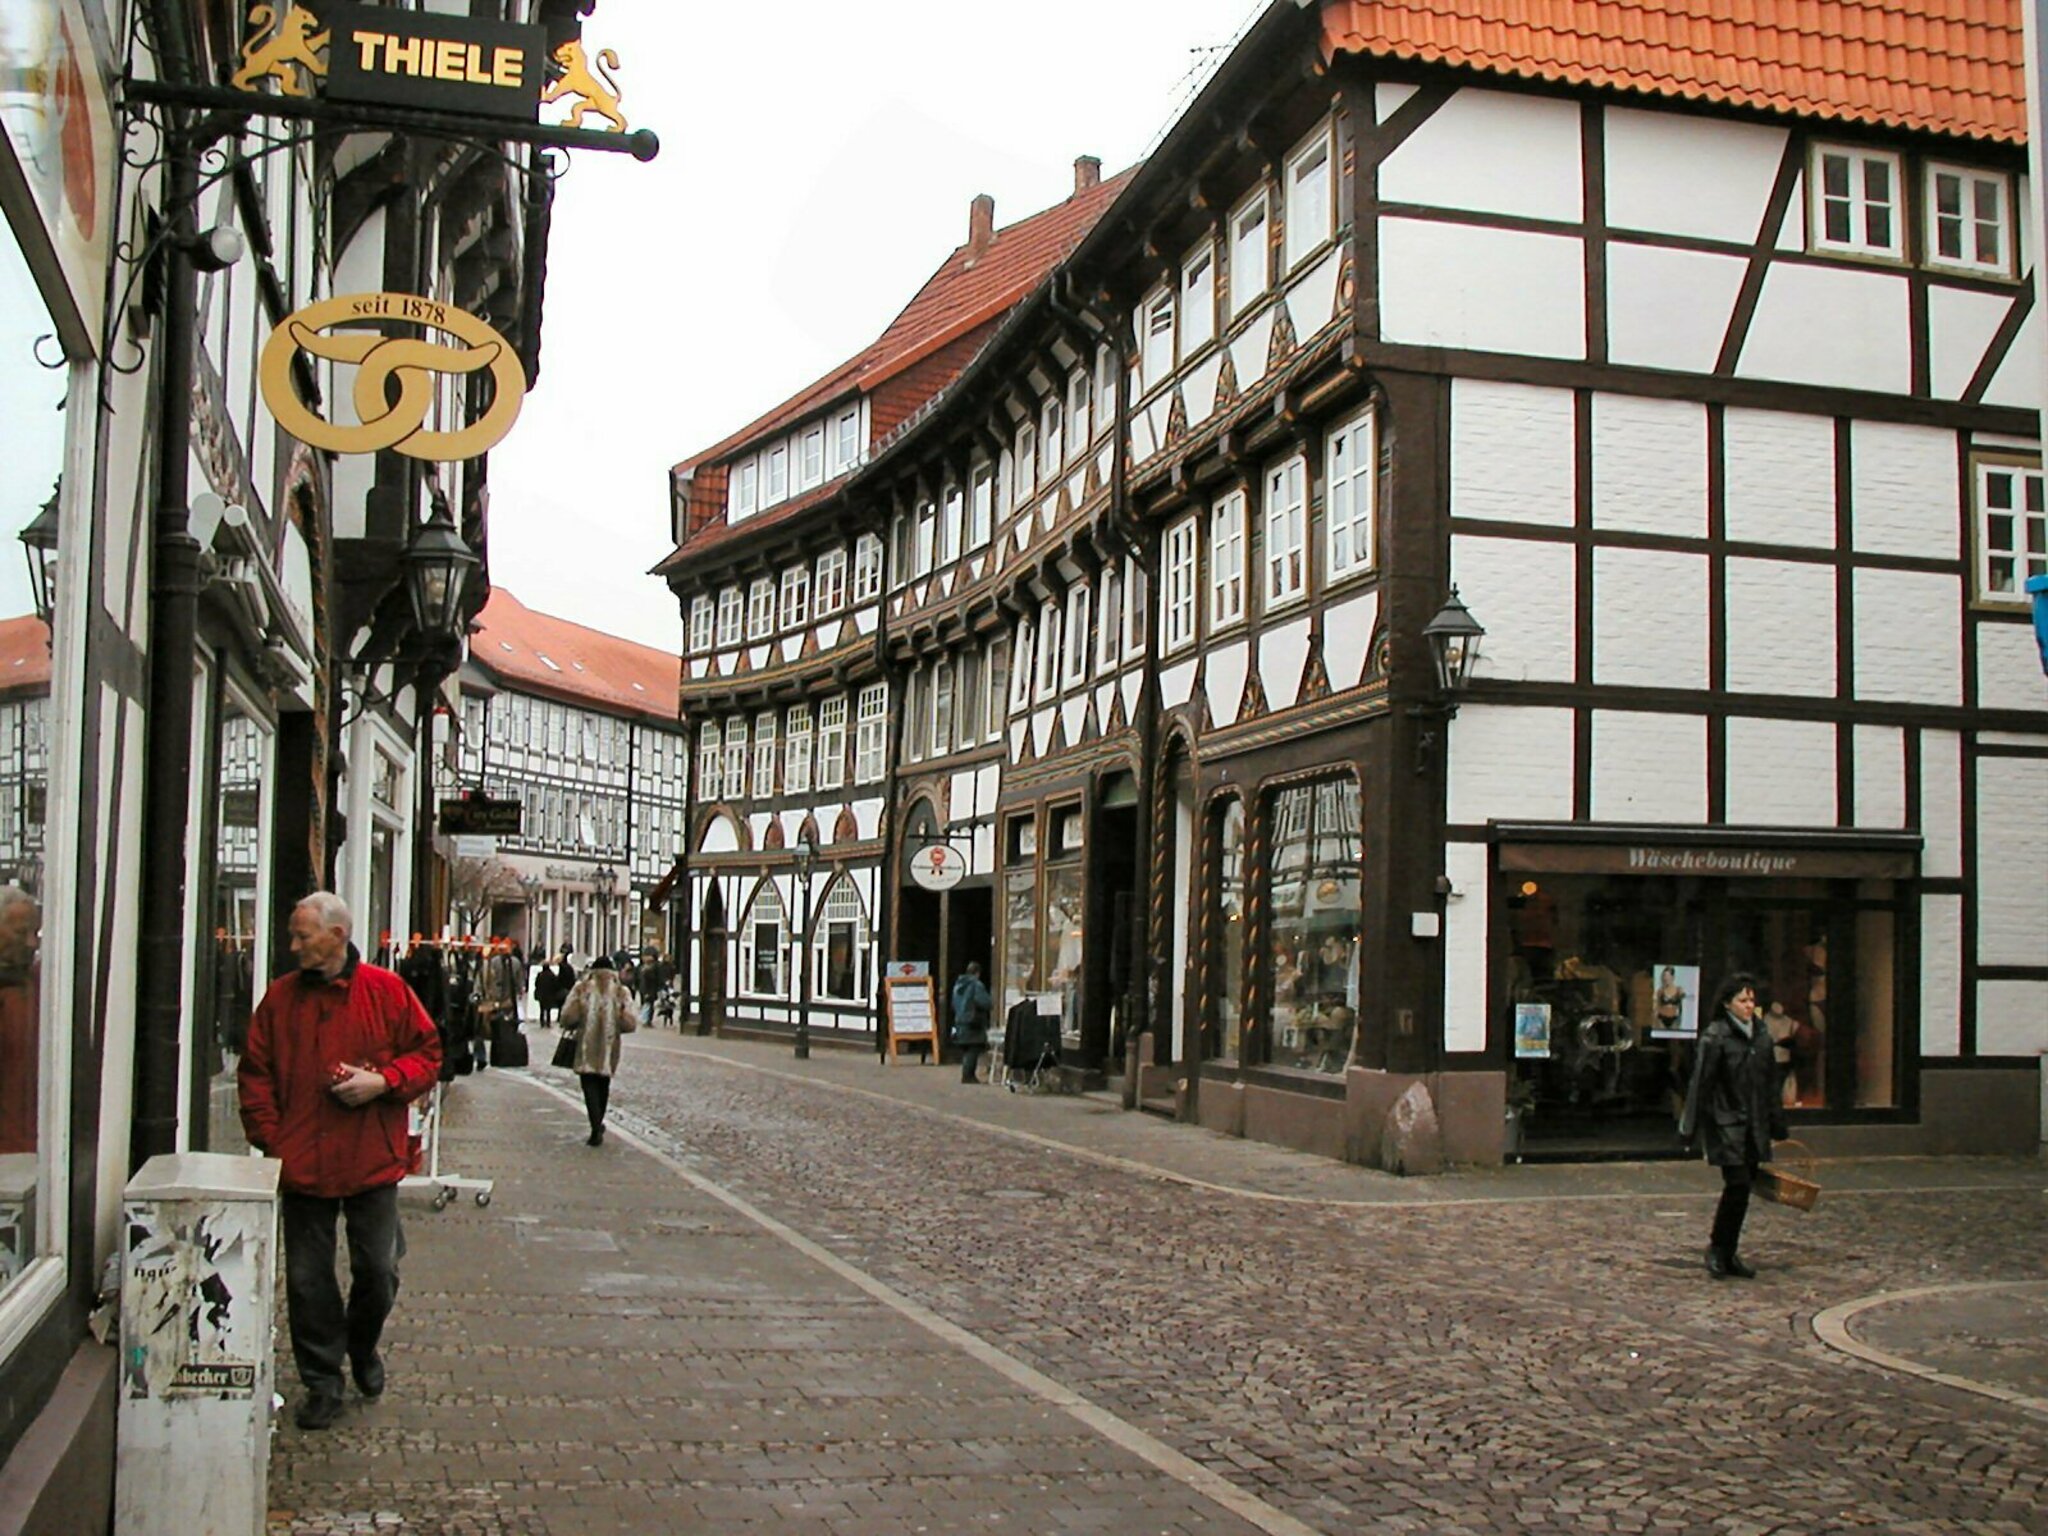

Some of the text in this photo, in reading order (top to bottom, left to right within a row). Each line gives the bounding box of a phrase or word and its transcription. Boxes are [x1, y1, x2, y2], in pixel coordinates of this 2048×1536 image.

[353, 31, 524, 87] THIELE
[352, 295, 445, 324] seit 1878
[1629, 848, 1797, 874] Wäscheboutique
